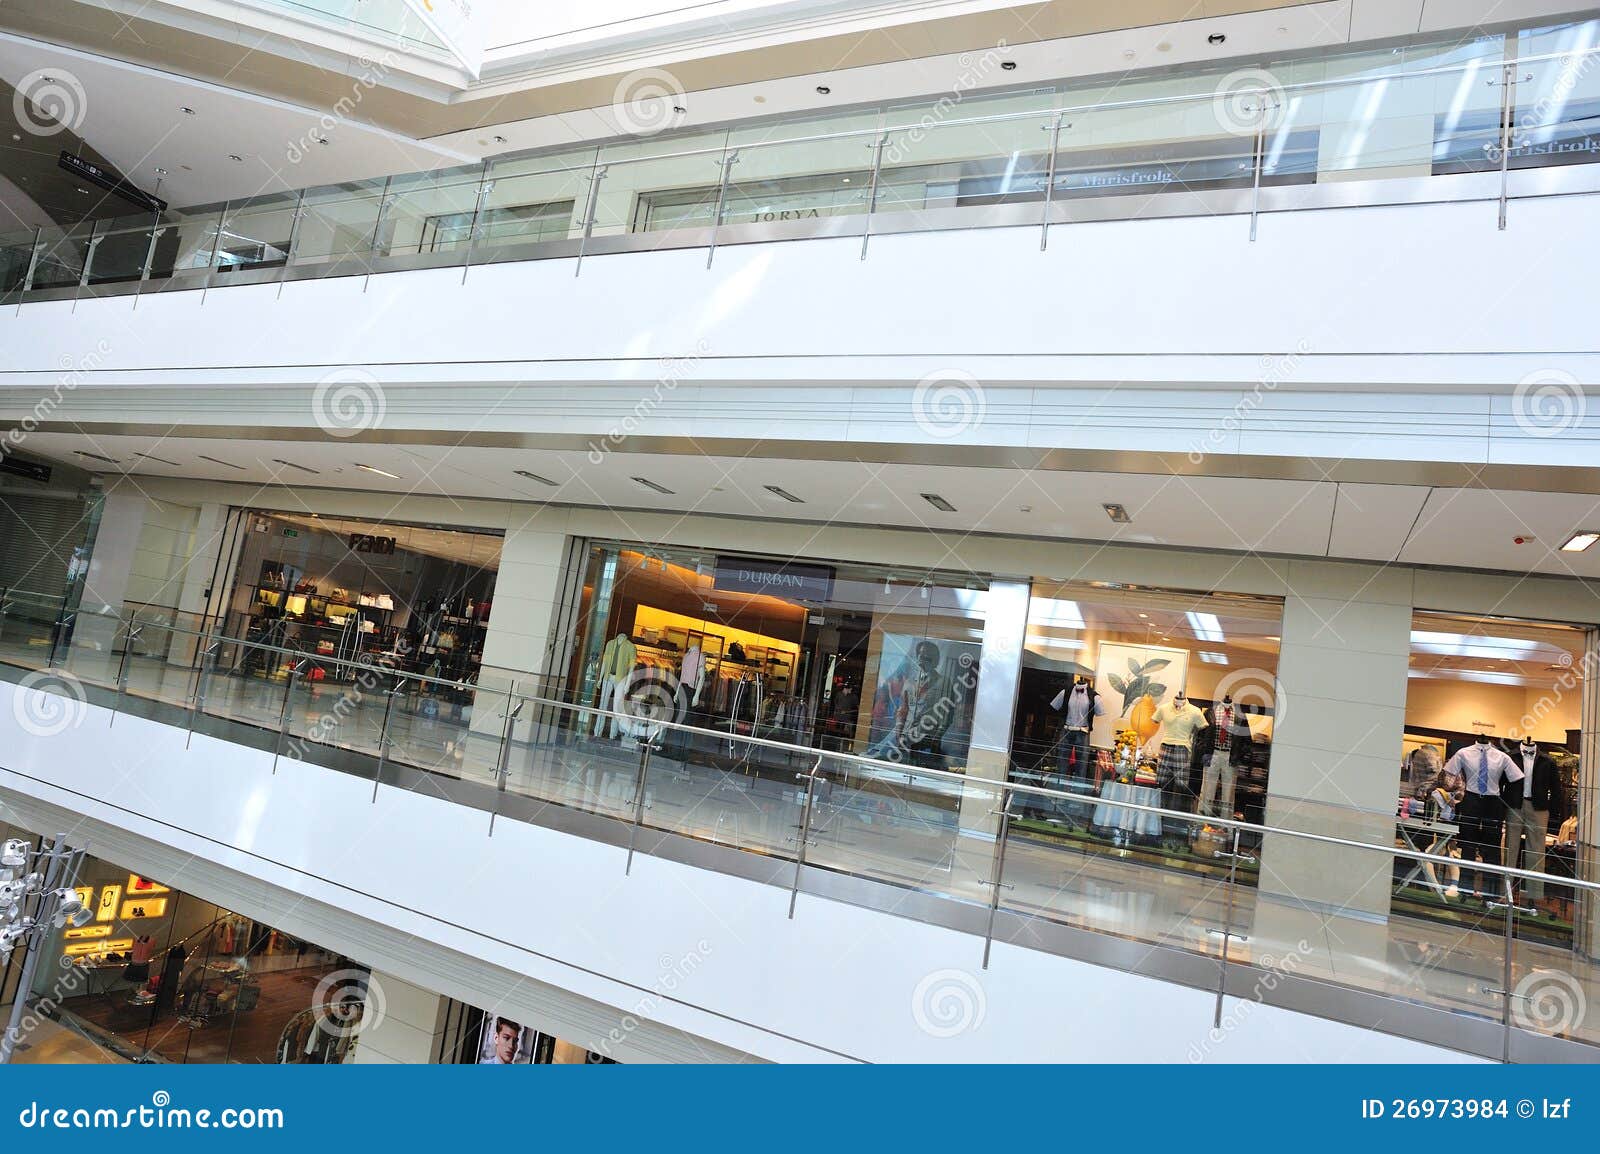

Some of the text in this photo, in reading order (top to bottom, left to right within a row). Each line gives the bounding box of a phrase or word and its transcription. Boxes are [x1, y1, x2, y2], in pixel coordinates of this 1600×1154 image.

[1081, 169, 1173, 186] Marisfrolg
[750, 208, 819, 223] JORYA
[738, 569, 804, 587] DURBAN
